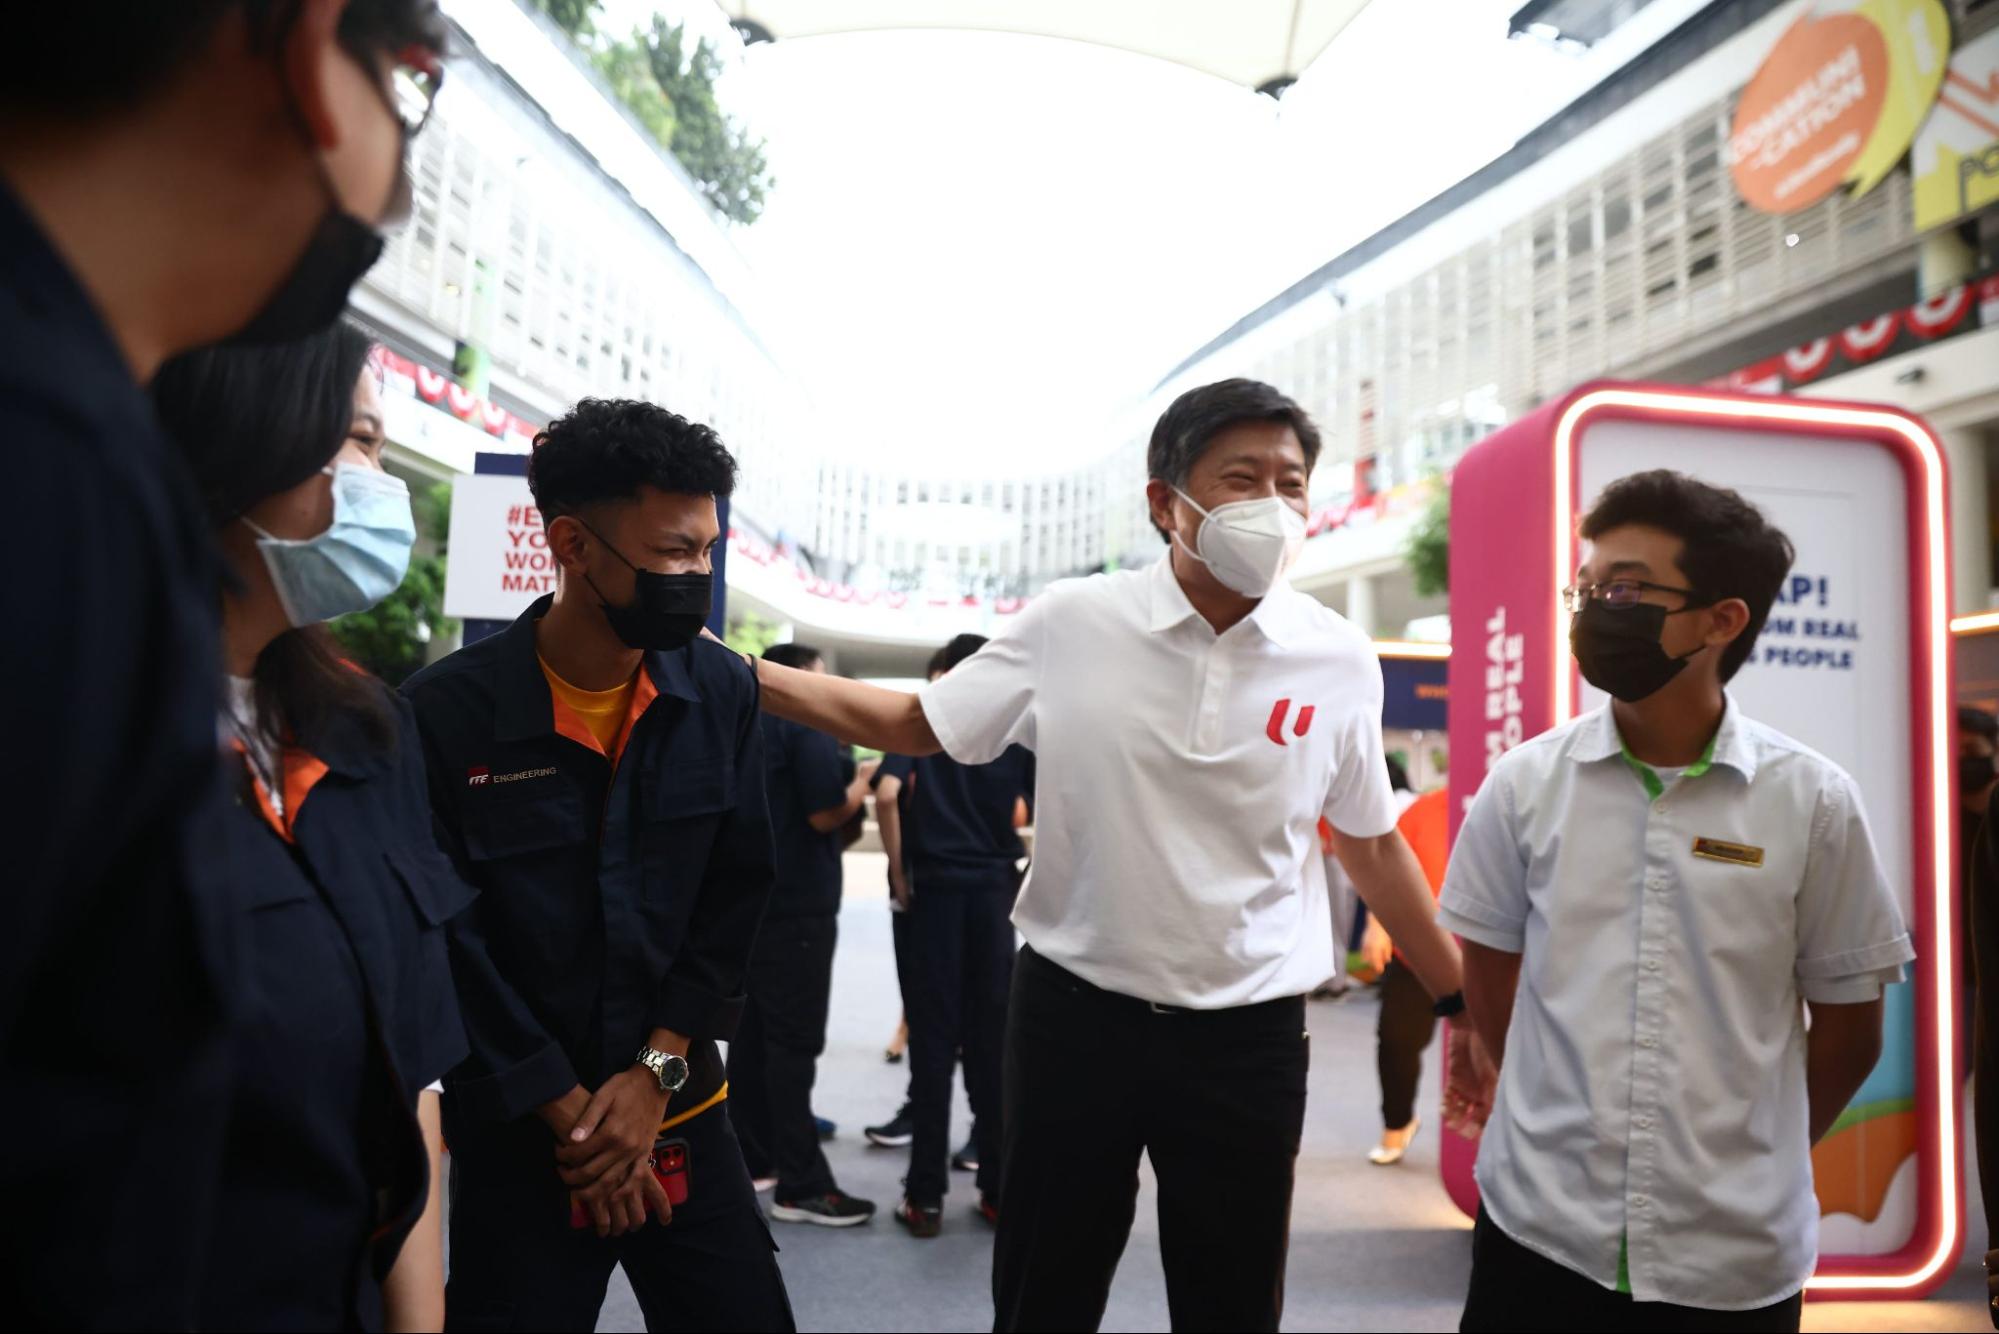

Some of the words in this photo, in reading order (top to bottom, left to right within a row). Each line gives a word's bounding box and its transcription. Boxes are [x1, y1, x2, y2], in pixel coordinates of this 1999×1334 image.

[502, 575, 556, 592] MAT
[1804, 619, 1860, 640] REAL
[1486, 606, 1505, 720] REAL
[1765, 648, 1852, 669] PEOPLE
[493, 767, 557, 784] ENGINEERING
